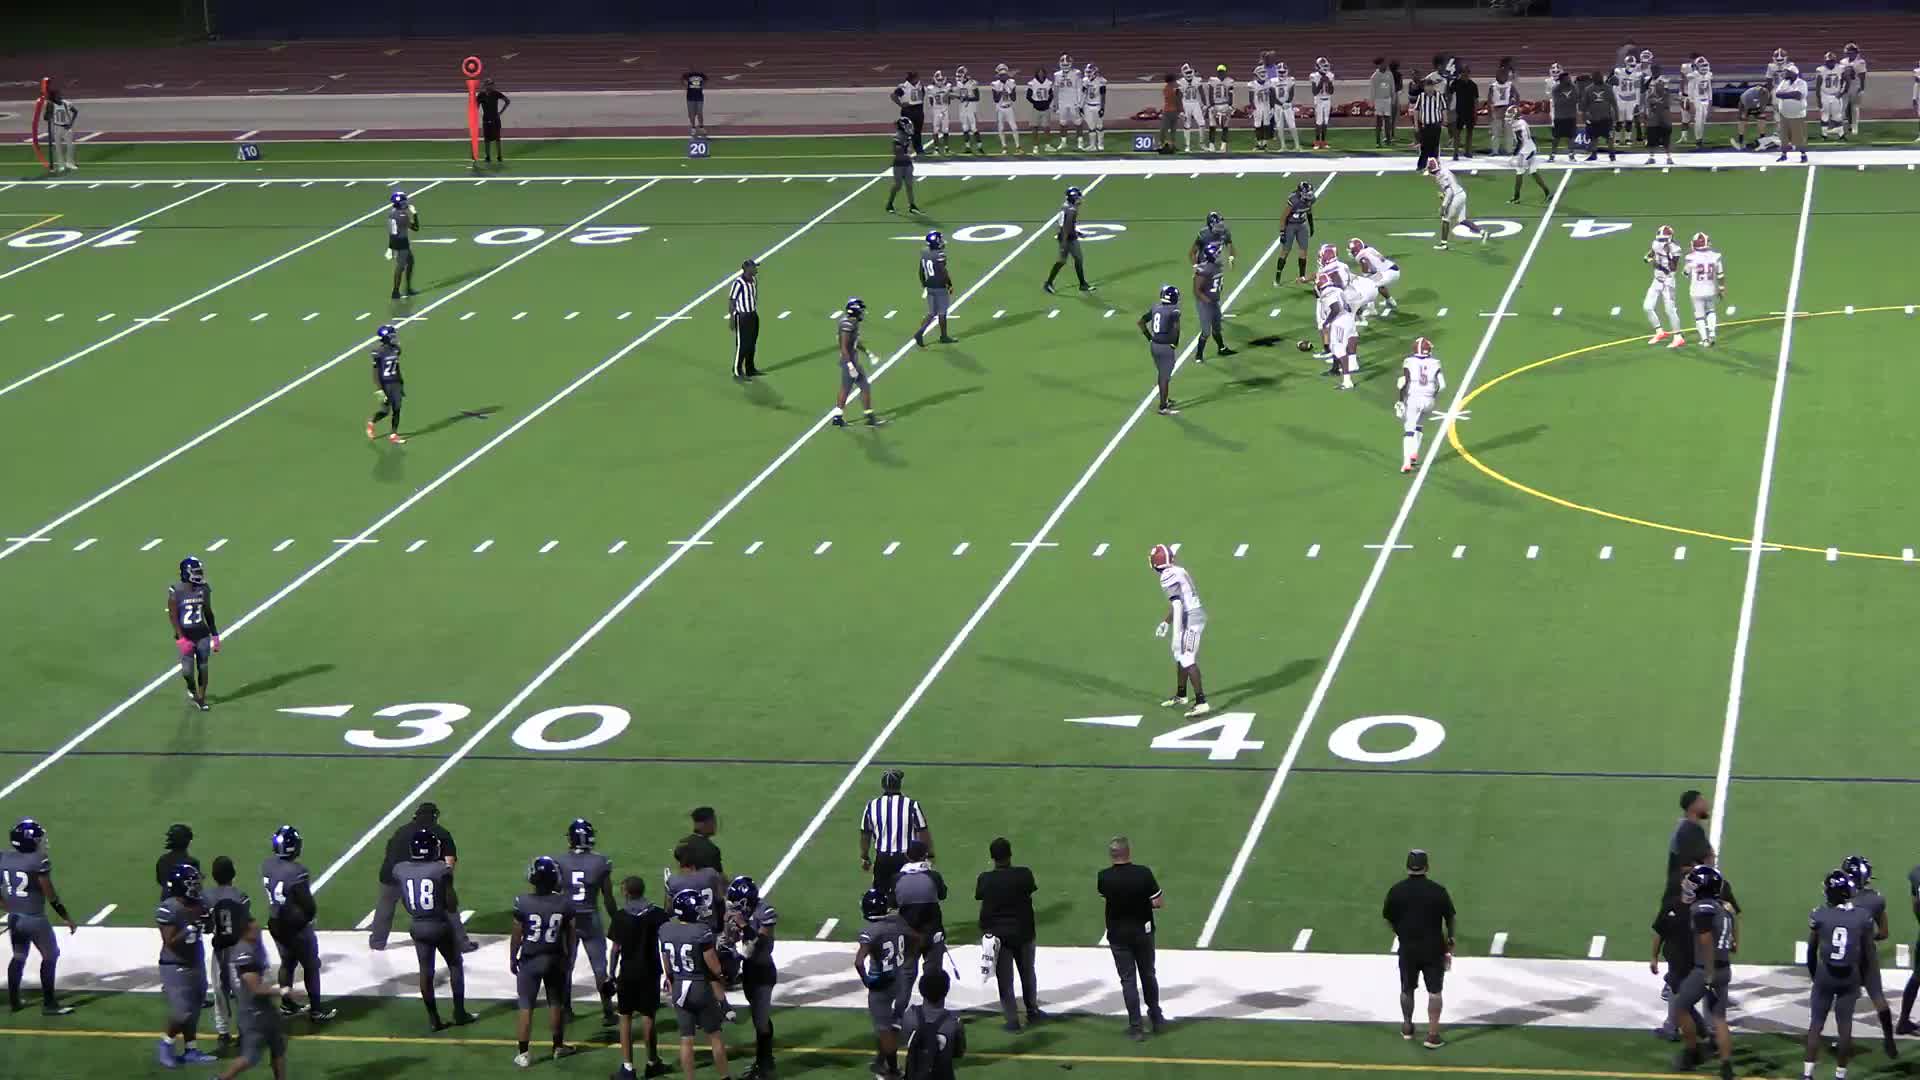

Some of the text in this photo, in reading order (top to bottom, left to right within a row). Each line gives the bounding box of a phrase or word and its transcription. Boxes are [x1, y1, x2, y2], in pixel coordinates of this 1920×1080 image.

[244, 145, 258, 157] 10
[689, 143, 706, 155] 20
[1135, 137, 1152, 149] 30
[473, 226, 651, 245] 20
[921, 258, 935, 281] 10
[1152, 312, 1161, 334] 8
[183, 603, 203, 625] 23
[344, 702, 631, 751] 30
[1150, 712, 1446, 762] 40
[3, 870, 29, 898] 12
[406, 878, 434, 911] 18
[571, 871, 586, 901] 5
[882, 934, 905, 973] 28
[1830, 926, 1849, 960] 9
